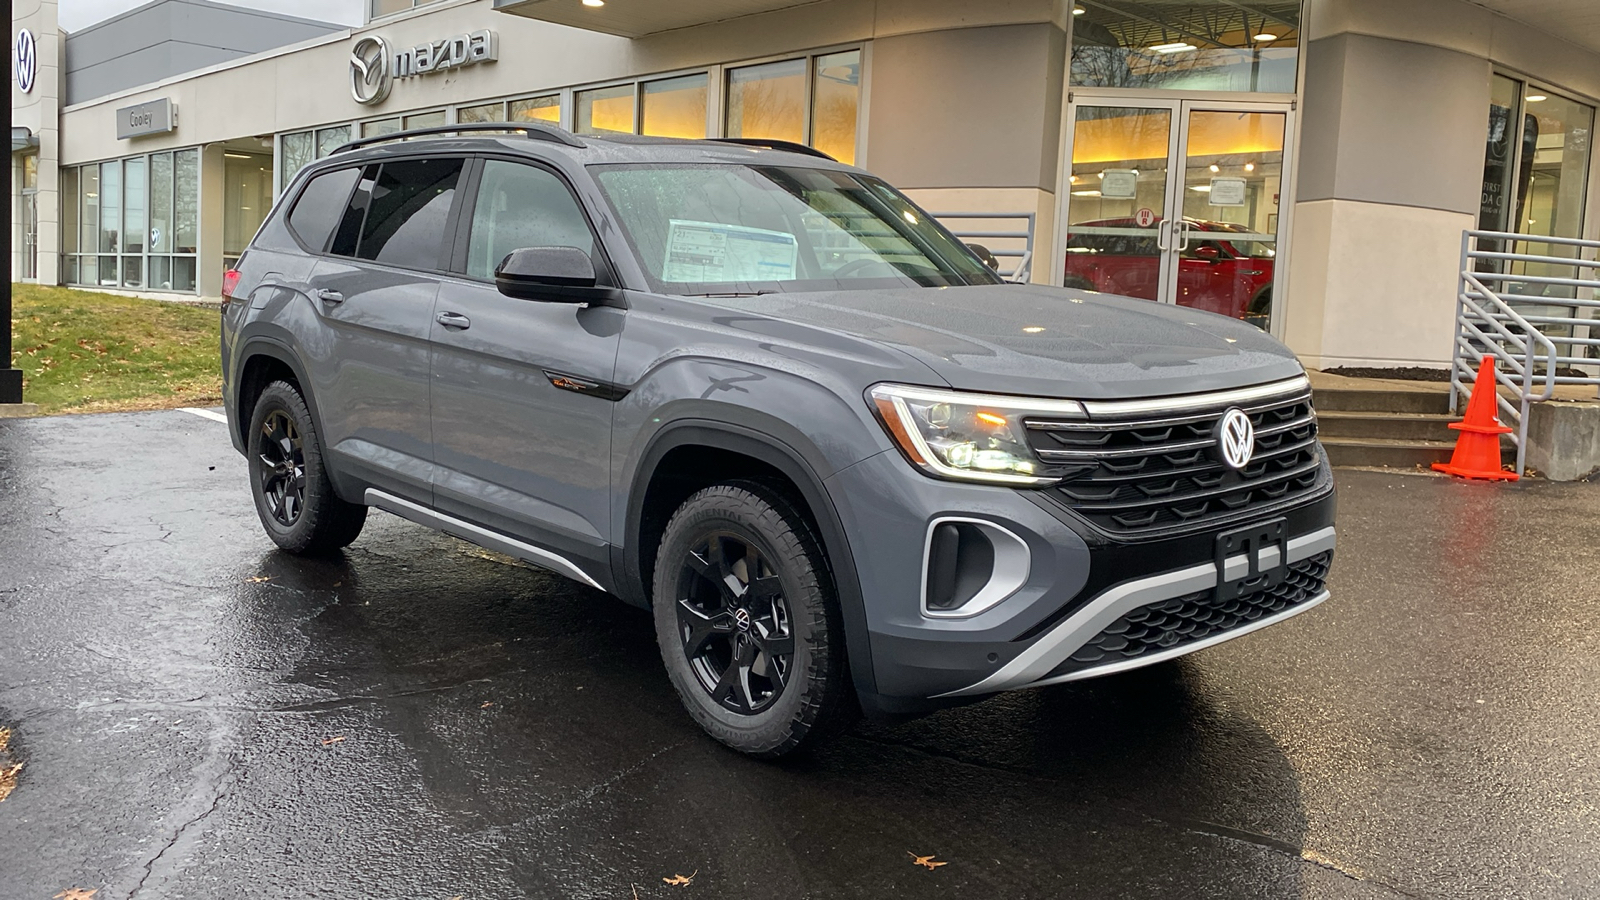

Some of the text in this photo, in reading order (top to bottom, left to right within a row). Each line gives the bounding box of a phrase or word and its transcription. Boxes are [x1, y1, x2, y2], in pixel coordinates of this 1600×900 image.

[130, 107, 153, 128] Cooley
[1483, 181, 1501, 192] FIRST
[1141, 217, 1148, 225] R
